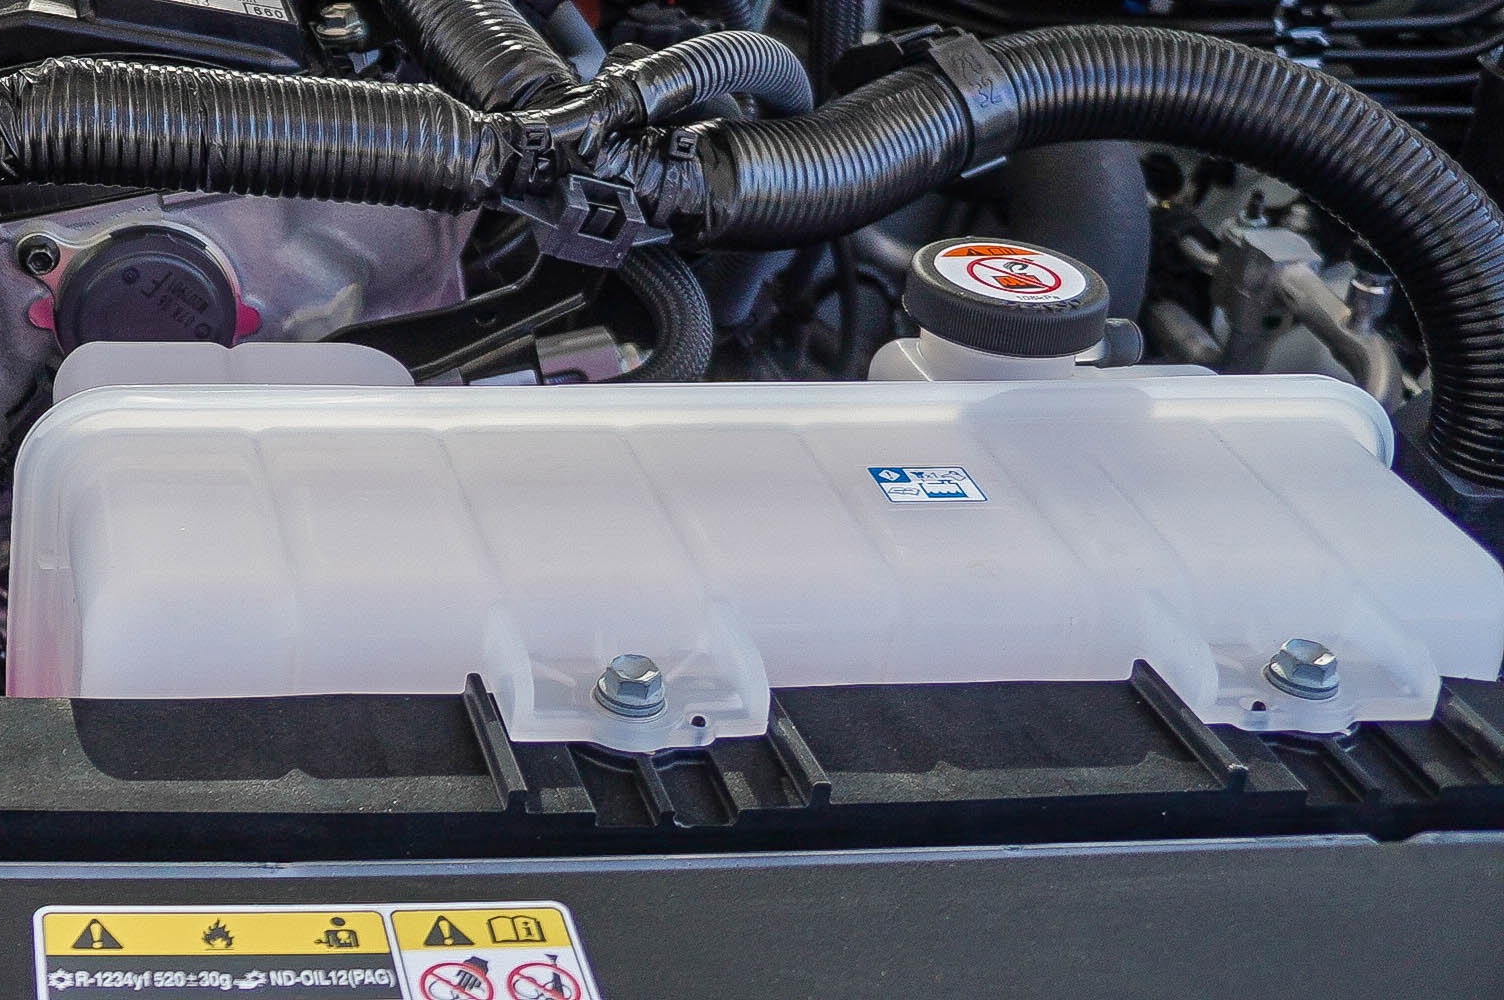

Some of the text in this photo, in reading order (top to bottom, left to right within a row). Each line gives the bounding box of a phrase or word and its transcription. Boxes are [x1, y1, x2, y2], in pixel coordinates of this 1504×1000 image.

[74, 968, 396, 991] R-1234yf 520±30g ND-OIL12(PAG)
